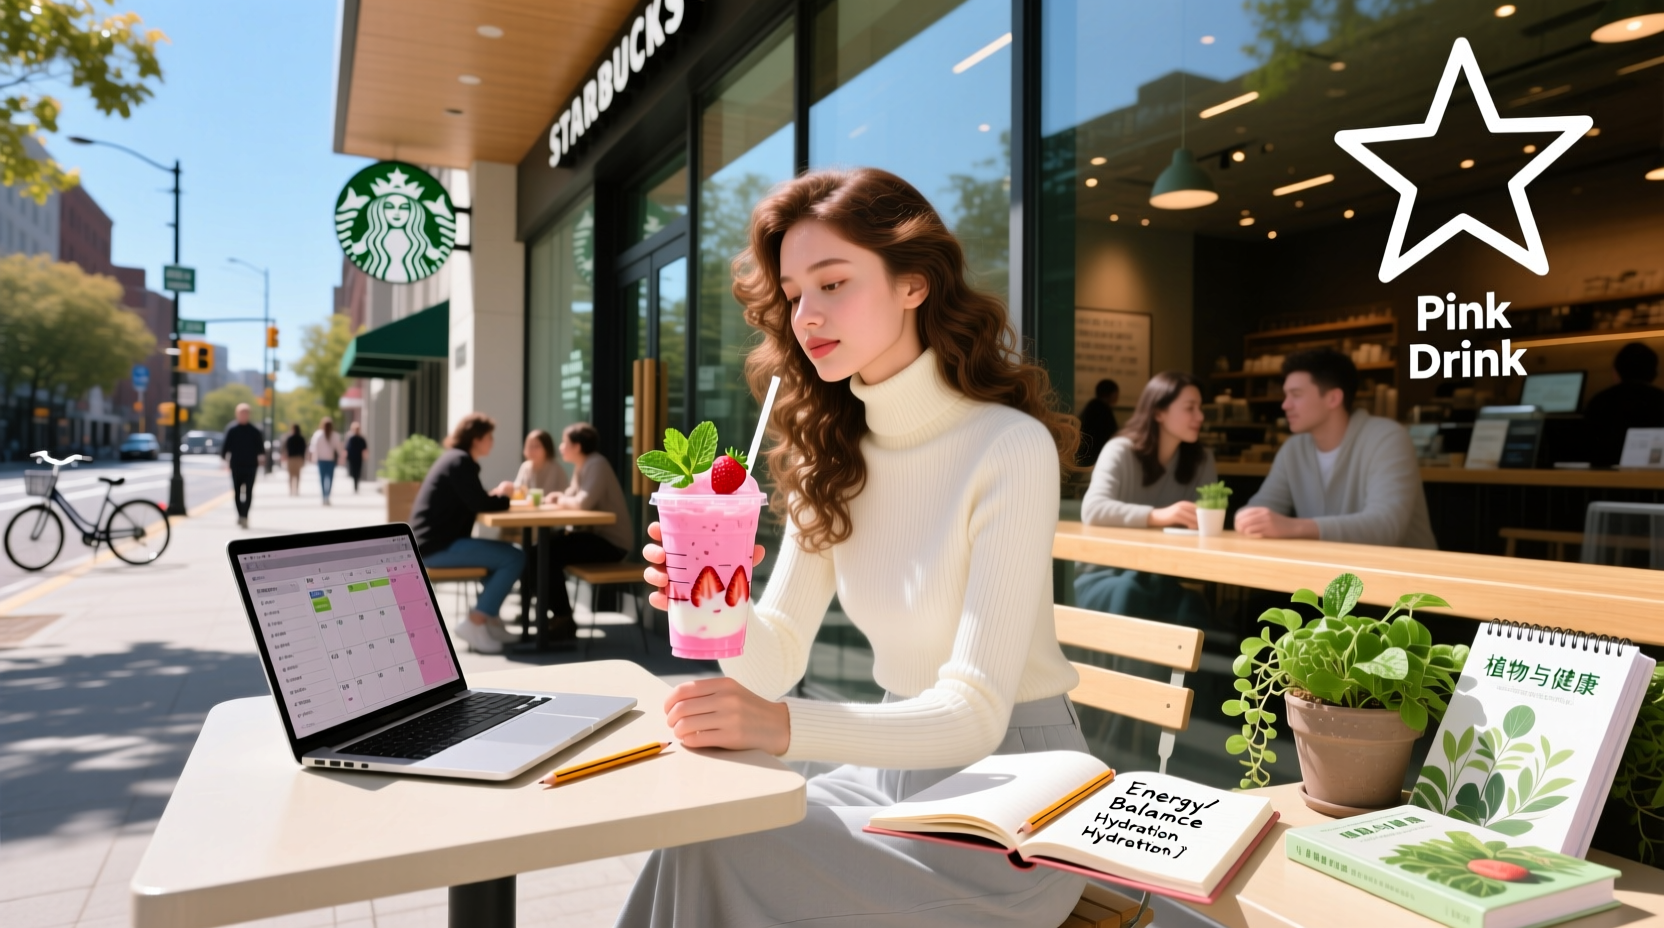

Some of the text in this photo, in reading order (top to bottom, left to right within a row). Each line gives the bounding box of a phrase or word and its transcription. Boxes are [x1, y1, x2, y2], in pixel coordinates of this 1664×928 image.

[549, 0, 685, 168] STARBUCKS
[1417, 291, 1512, 331] Pink
[1409, 339, 1528, 379] Drink
[1484, 654, 1600, 695] 植物与健康
[1094, 812, 1178, 841] Hydration
